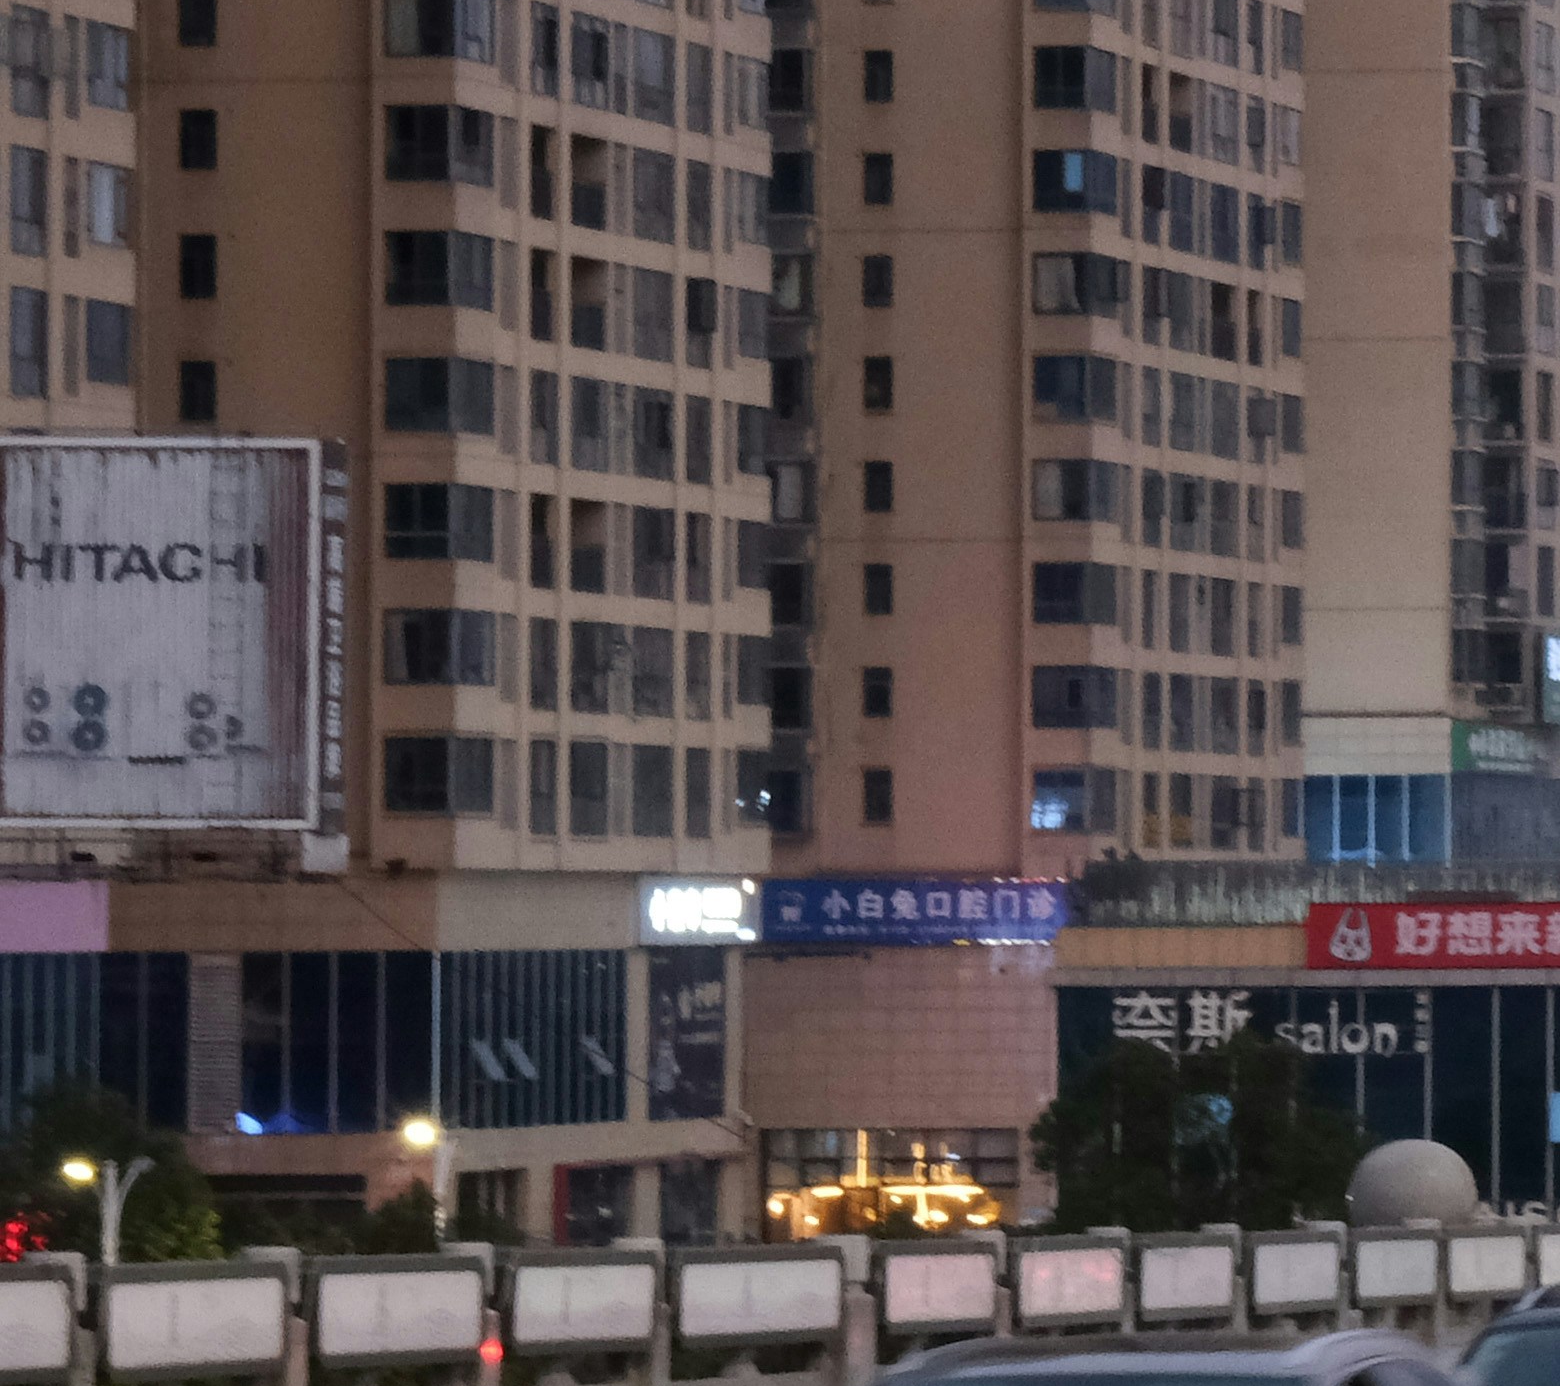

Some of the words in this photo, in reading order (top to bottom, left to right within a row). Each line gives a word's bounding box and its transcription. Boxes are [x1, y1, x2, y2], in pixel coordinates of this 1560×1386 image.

[820, 888, 1059, 922] 小白兔口腔门诊
[1274, 999, 1399, 1058] salon
